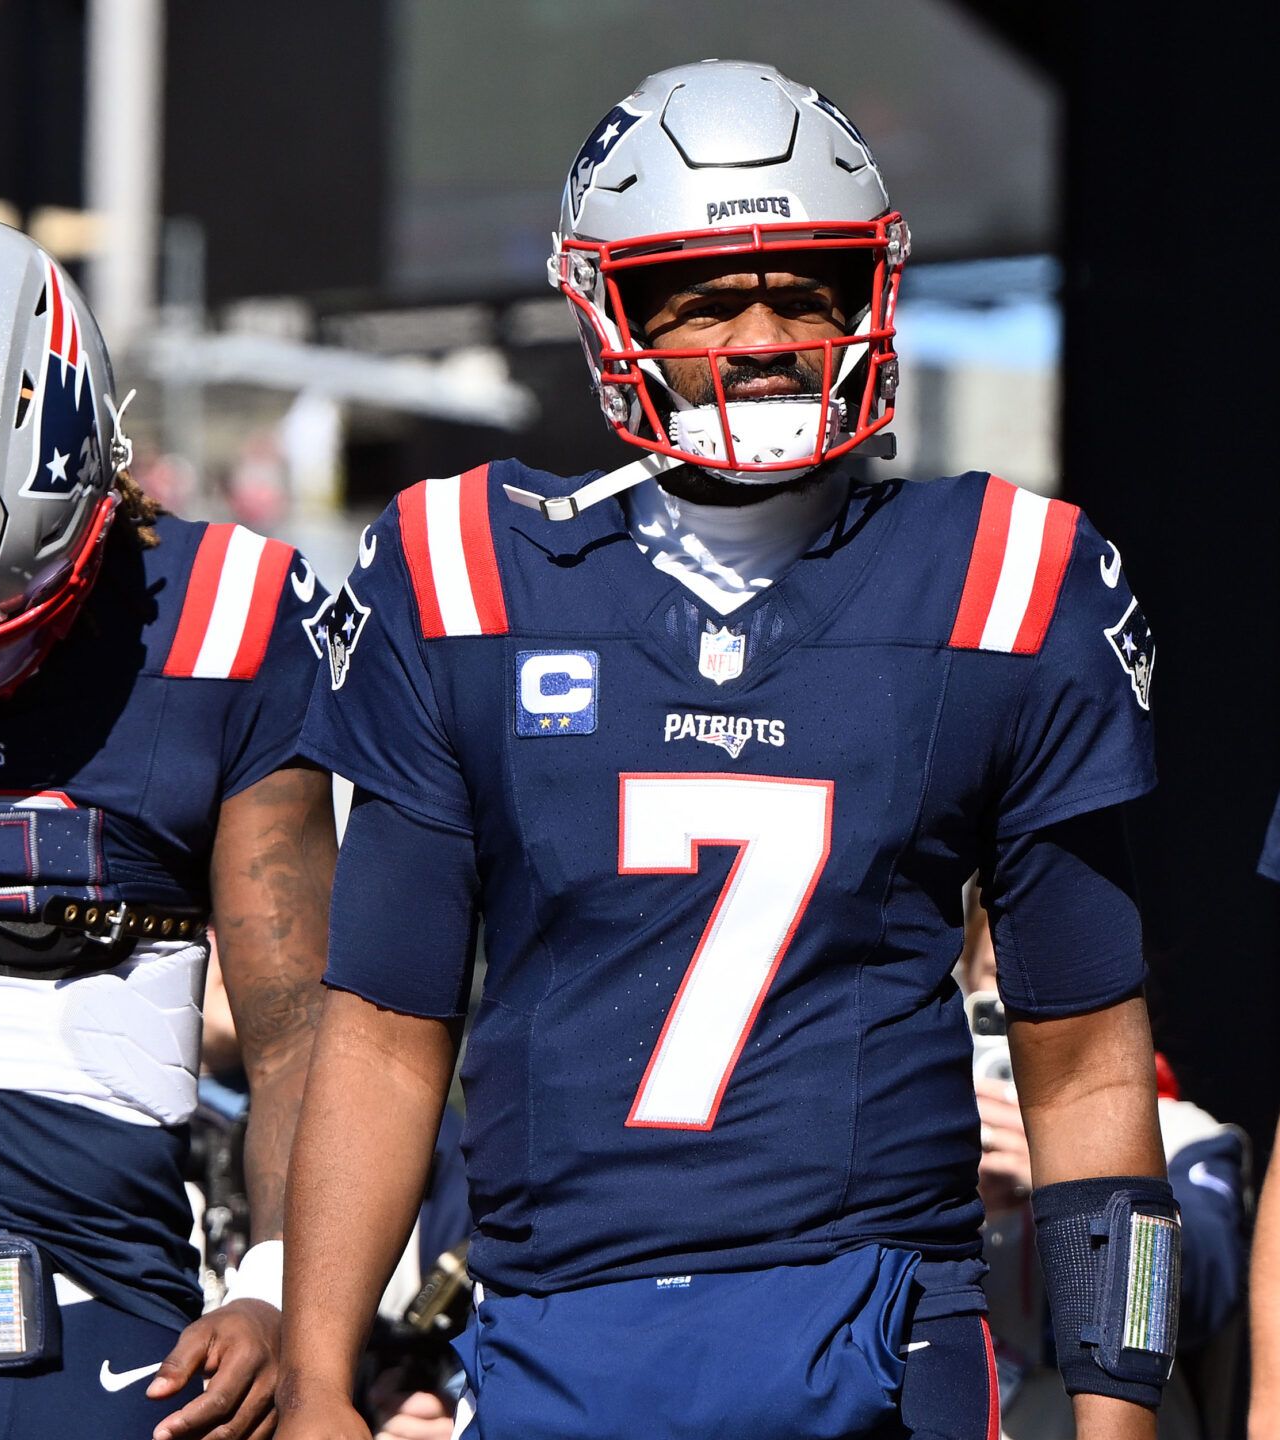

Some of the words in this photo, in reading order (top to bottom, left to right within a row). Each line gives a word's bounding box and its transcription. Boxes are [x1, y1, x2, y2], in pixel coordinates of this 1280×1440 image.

[706, 196, 791, 225] PATRIOTS
[706, 653, 737, 673] NFL
[520, 654, 593, 714] C
[664, 713, 786, 748] PATRIOTS
[618, 772, 835, 1132] 7
